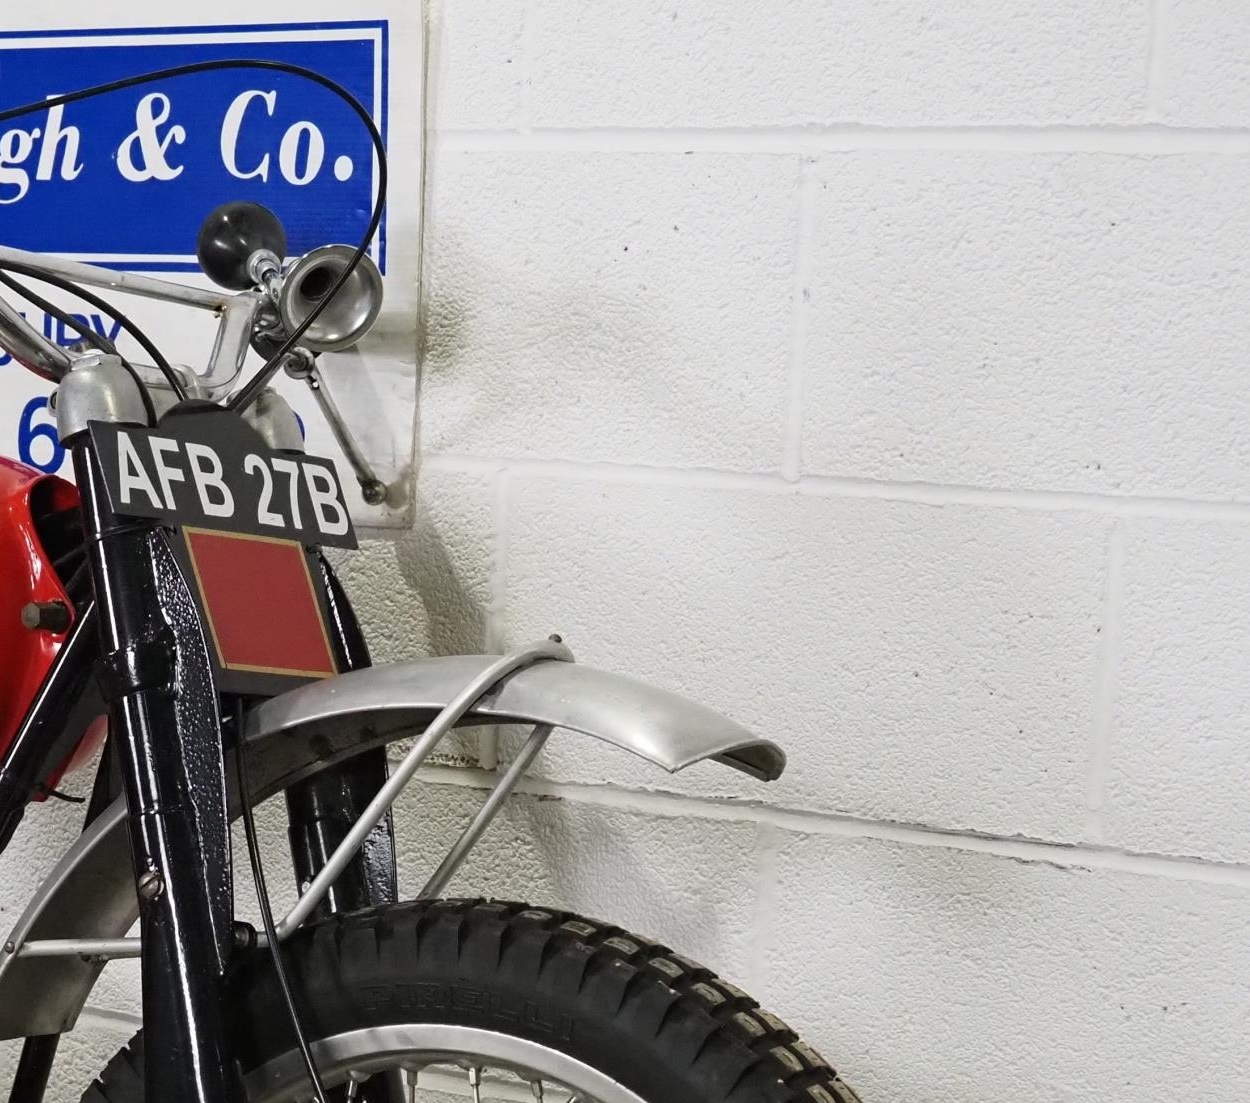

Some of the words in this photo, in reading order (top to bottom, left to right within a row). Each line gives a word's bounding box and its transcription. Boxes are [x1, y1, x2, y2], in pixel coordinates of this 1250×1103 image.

[116, 92, 186, 182] &
[220, 89, 354, 186] Co.
[117, 431, 235, 518] AFB
[244, 453, 349, 536] 27B
